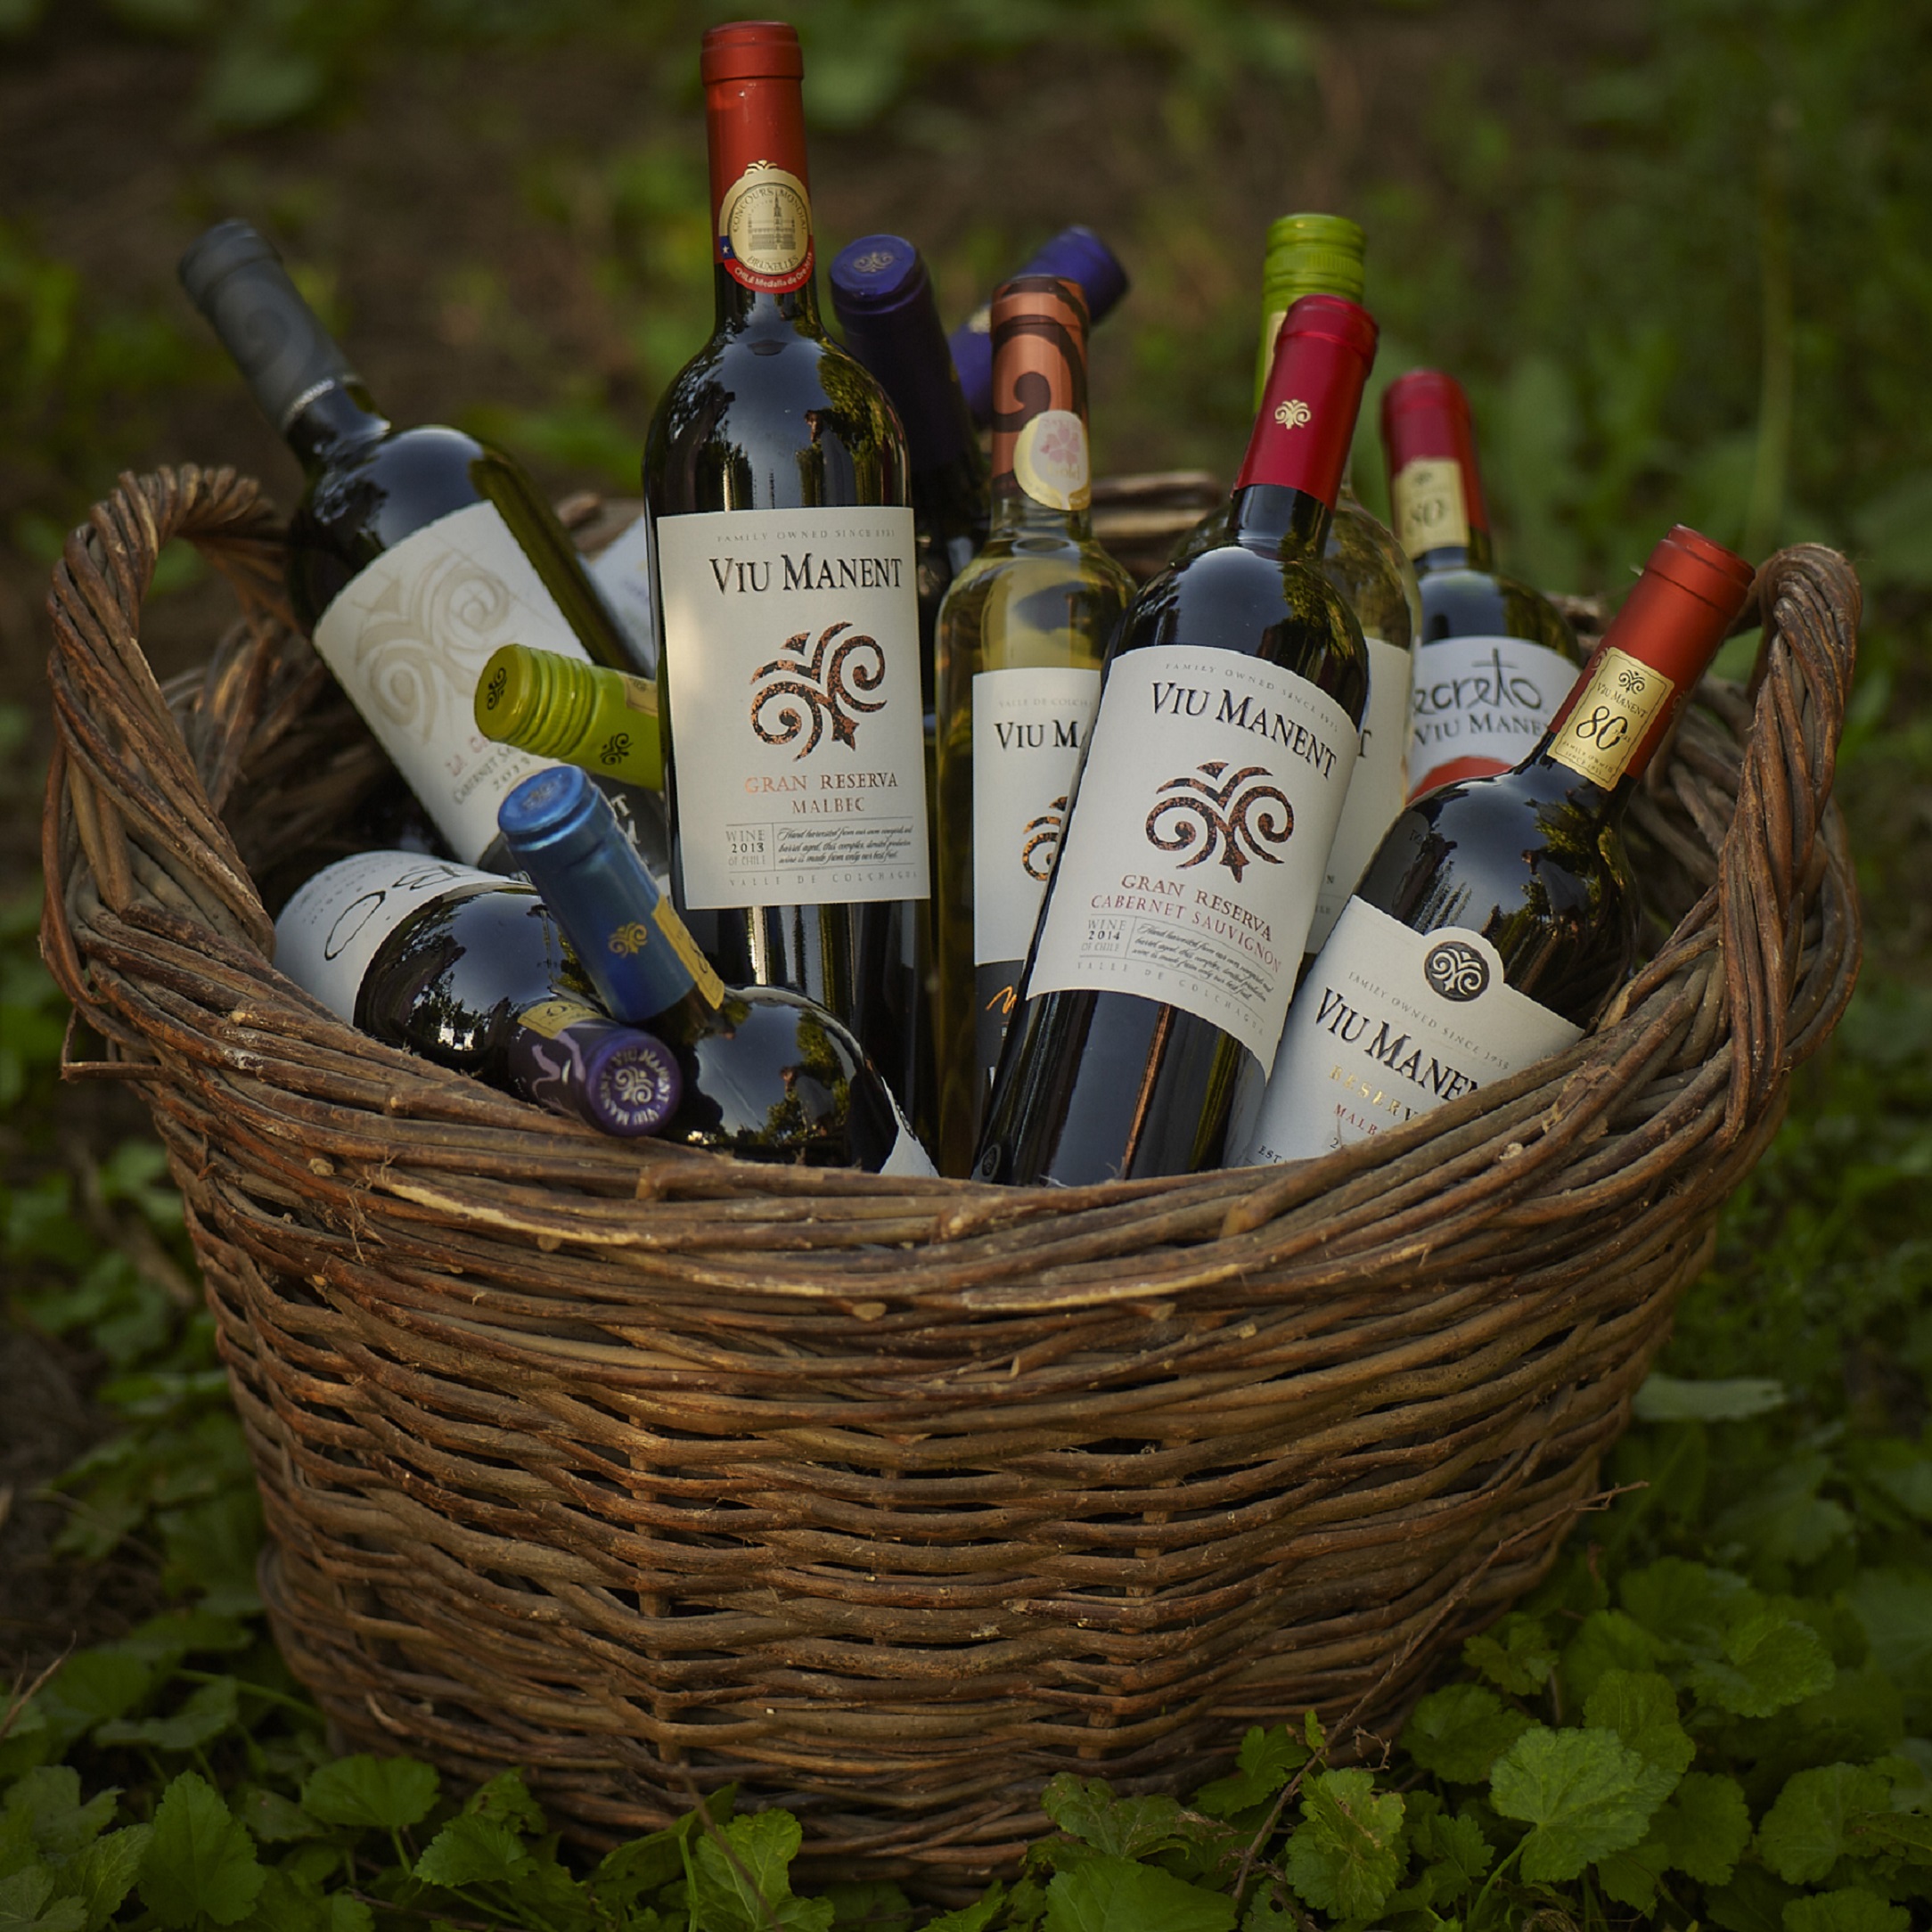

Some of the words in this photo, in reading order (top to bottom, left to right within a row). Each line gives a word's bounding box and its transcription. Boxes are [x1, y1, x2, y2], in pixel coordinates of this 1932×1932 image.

[733, 187, 774, 233] CONCOURS
[779, 187, 806, 231] MONDIAL
[746, 255, 799, 272] BRUXELLES
[716, 532, 768, 543] FAMILY
[776, 530, 828, 540] OWNED
[835, 529, 872, 538] SINCE
[708, 556, 772, 595] VIU
[781, 553, 903, 592] MANENT
[1165, 663, 1216, 673] FAMILY
[1224, 668, 1275, 691] OWNED
[1281, 688, 1316, 714] SINCE
[994, 721, 1045, 752] VIU
[1152, 682, 1211, 716] VIU
[1215, 689, 1338, 781] MANENT
[1576, 705, 1628, 750] 80
[744, 774, 808, 795] GRAN
[820, 772, 899, 790] RESERVA
[792, 797, 865, 815] MALBEC
[725, 829, 765, 842] WINE
[732, 842, 765, 854] 2013
[728, 856, 740, 867] OF
[741, 854, 766, 866] CHILE
[729, 875, 781, 887] VALLE
[798, 873, 817, 885] DE
[1121, 874, 1185, 897] GRAN
[1196, 889, 1273, 942] RESERVA
[1087, 919, 1127, 930] WINE
[1088, 930, 1120, 941] 2014
[1090, 894, 1187, 920] CABERNET
[1191, 911, 1281, 973] SAUVIGNON
[1094, 942, 1120, 952] CHILE
[1077, 962, 1128, 972] VALLE
[1144, 969, 1165, 979] DE
[1178, 978, 1264, 1036] COLCHAGUA
[1347, 970, 1387, 999] FAMILY
[1391, 996, 1437, 1028] OWNED
[1441, 1026, 1480, 1055] SINCE
[1314, 986, 1371, 1044] VIU
